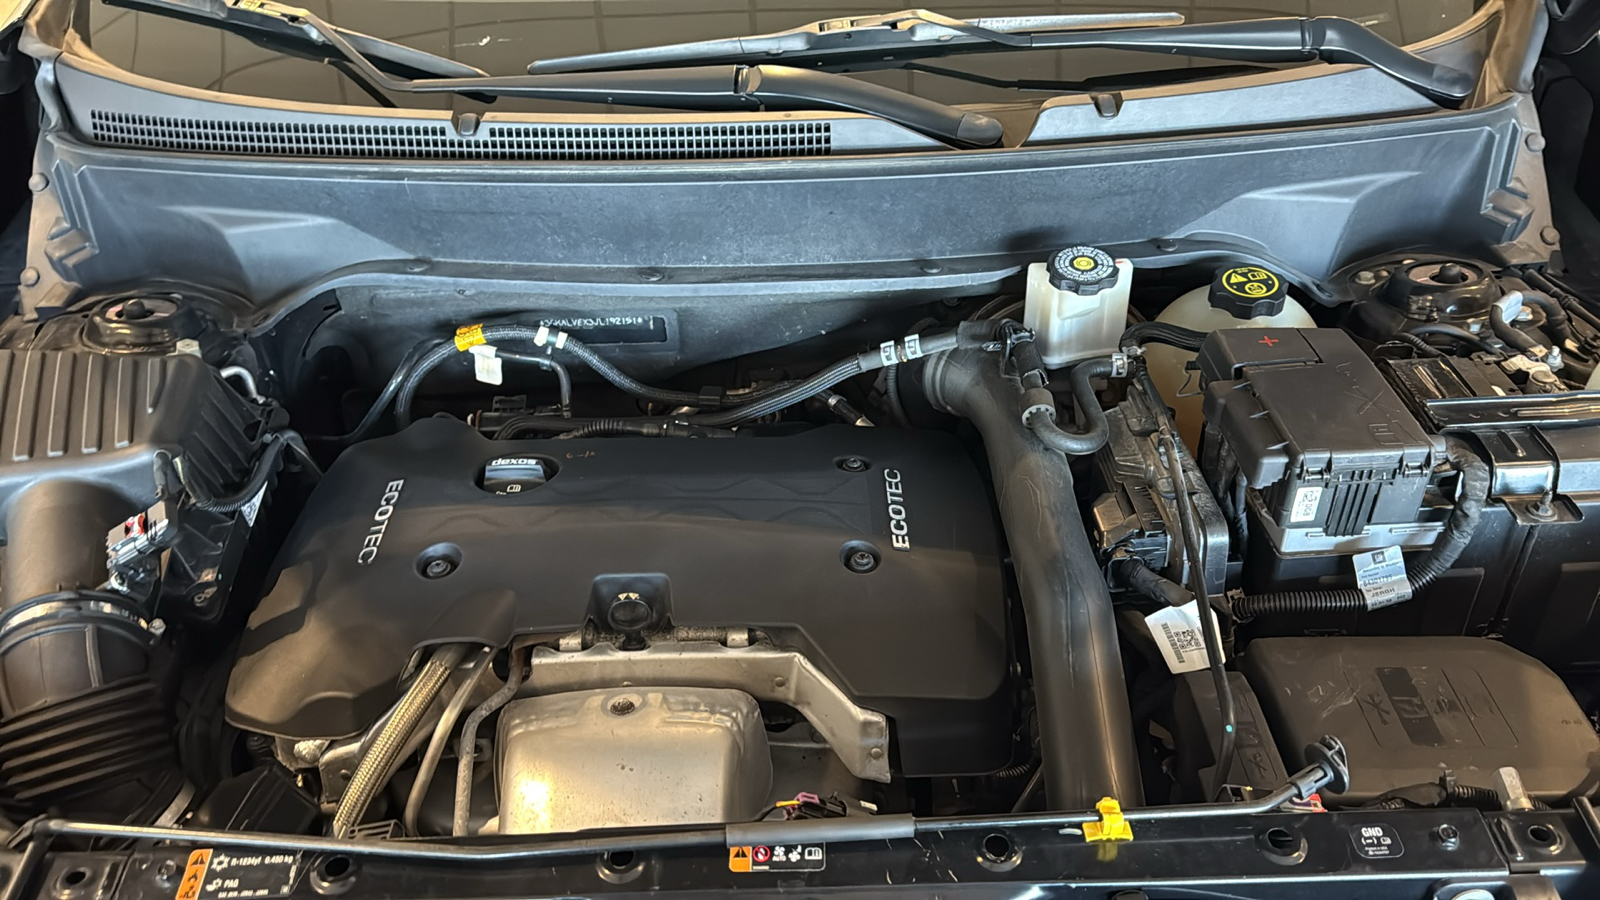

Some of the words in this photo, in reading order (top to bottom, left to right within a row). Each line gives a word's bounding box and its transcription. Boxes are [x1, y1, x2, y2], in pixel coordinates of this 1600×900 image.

[491, 457, 538, 466] dexos
[357, 479, 405, 565] ECOTEC
[884, 468, 910, 551] ECOTEC
[1361, 826, 1383, 837] GND
